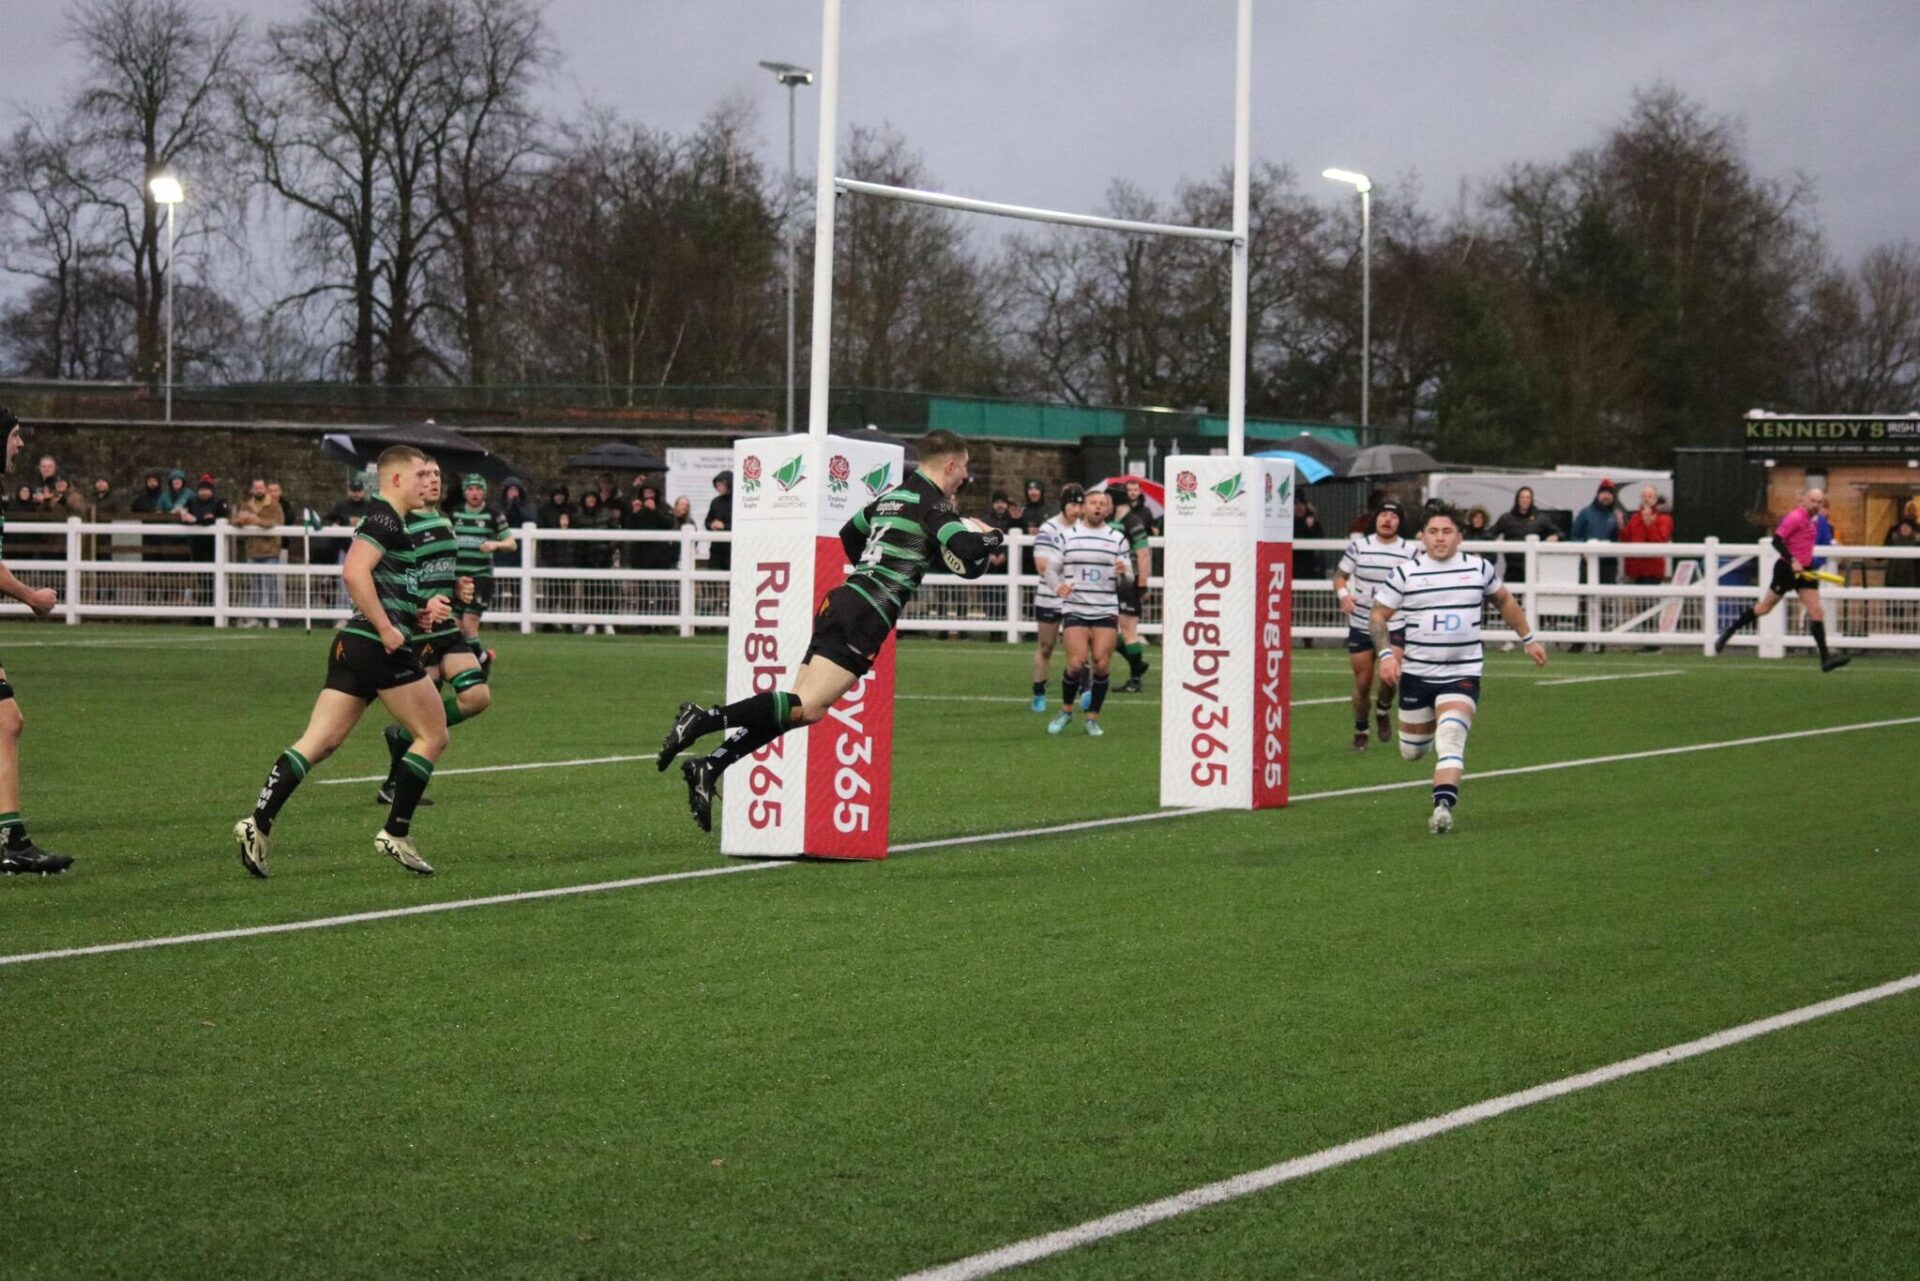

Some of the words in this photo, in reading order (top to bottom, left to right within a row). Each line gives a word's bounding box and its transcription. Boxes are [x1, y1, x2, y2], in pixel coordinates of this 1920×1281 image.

[1746, 421, 1885, 439] KENNEDY'S
[1082, 568, 1101, 581] HD
[1432, 614, 1462, 631] HD
[745, 562, 790, 830] Rugb365
[1182, 562, 1231, 787] Rugby365
[1262, 562, 1286, 789] Rugby365
